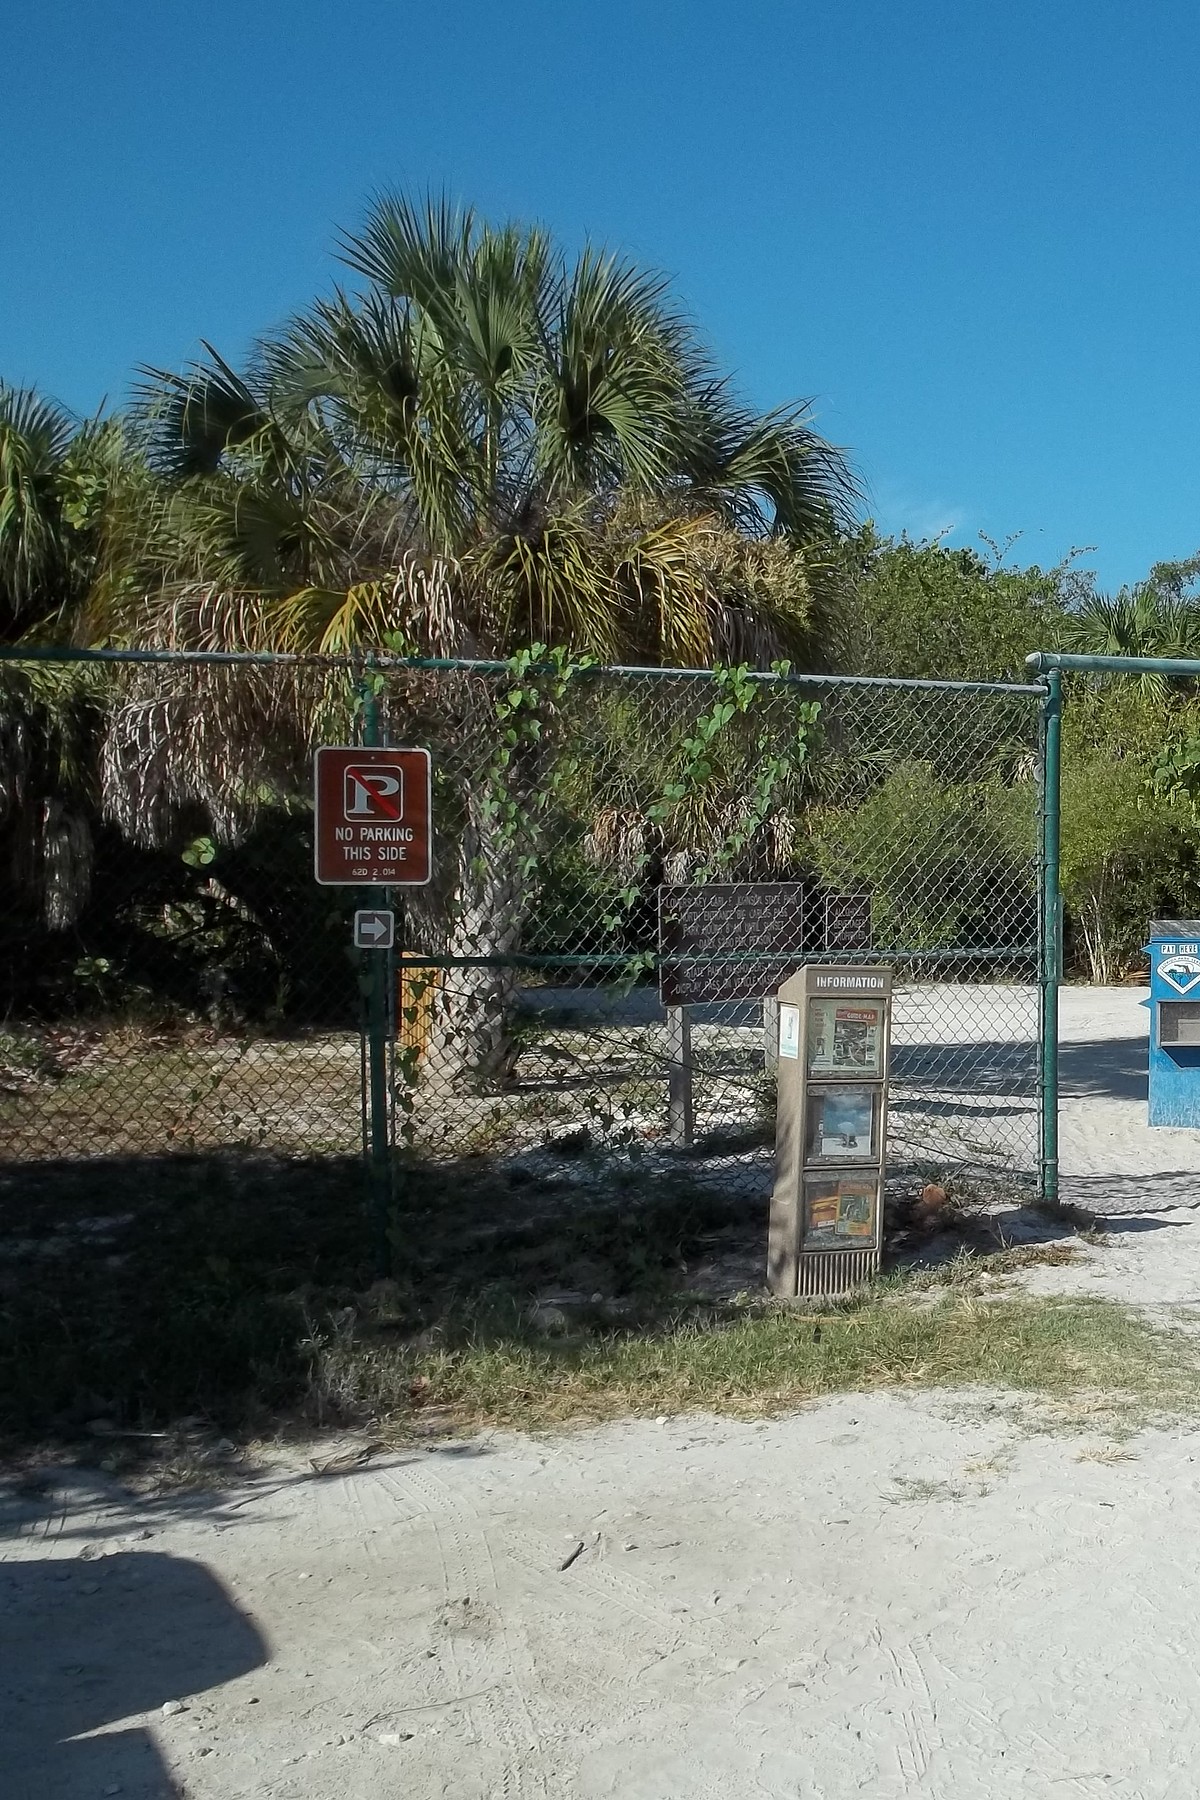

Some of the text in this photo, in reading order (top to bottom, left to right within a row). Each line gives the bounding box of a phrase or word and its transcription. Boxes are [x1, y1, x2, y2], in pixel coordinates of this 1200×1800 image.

[335, 827, 414, 842] NO PARKING
[342, 846, 407, 861] THIS SIDE
[1162, 945, 1197, 953] PAY HERE
[816, 976, 884, 988] INFORMATION
